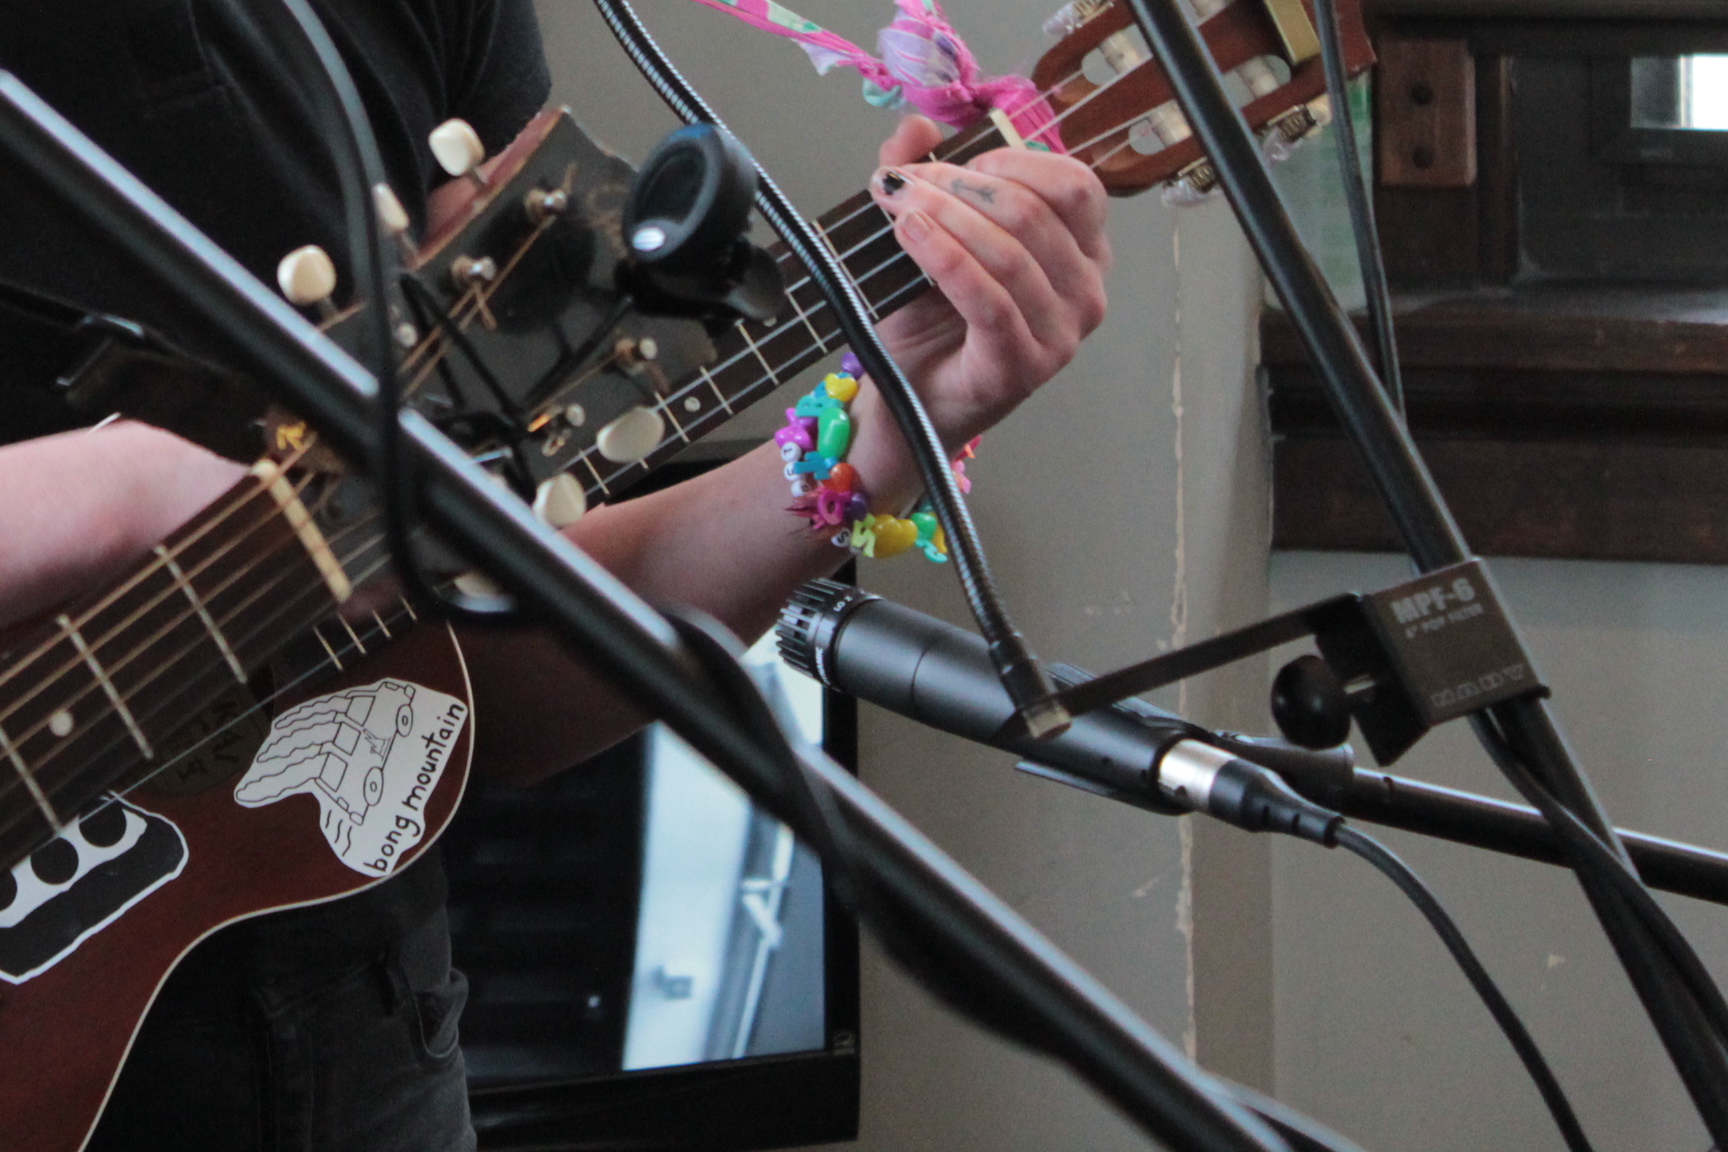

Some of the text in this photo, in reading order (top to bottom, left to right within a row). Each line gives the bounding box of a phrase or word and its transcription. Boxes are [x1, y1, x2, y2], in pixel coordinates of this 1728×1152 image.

[1390, 578, 1476, 625] MPF-6
[363, 703, 465, 872] bong mountain
